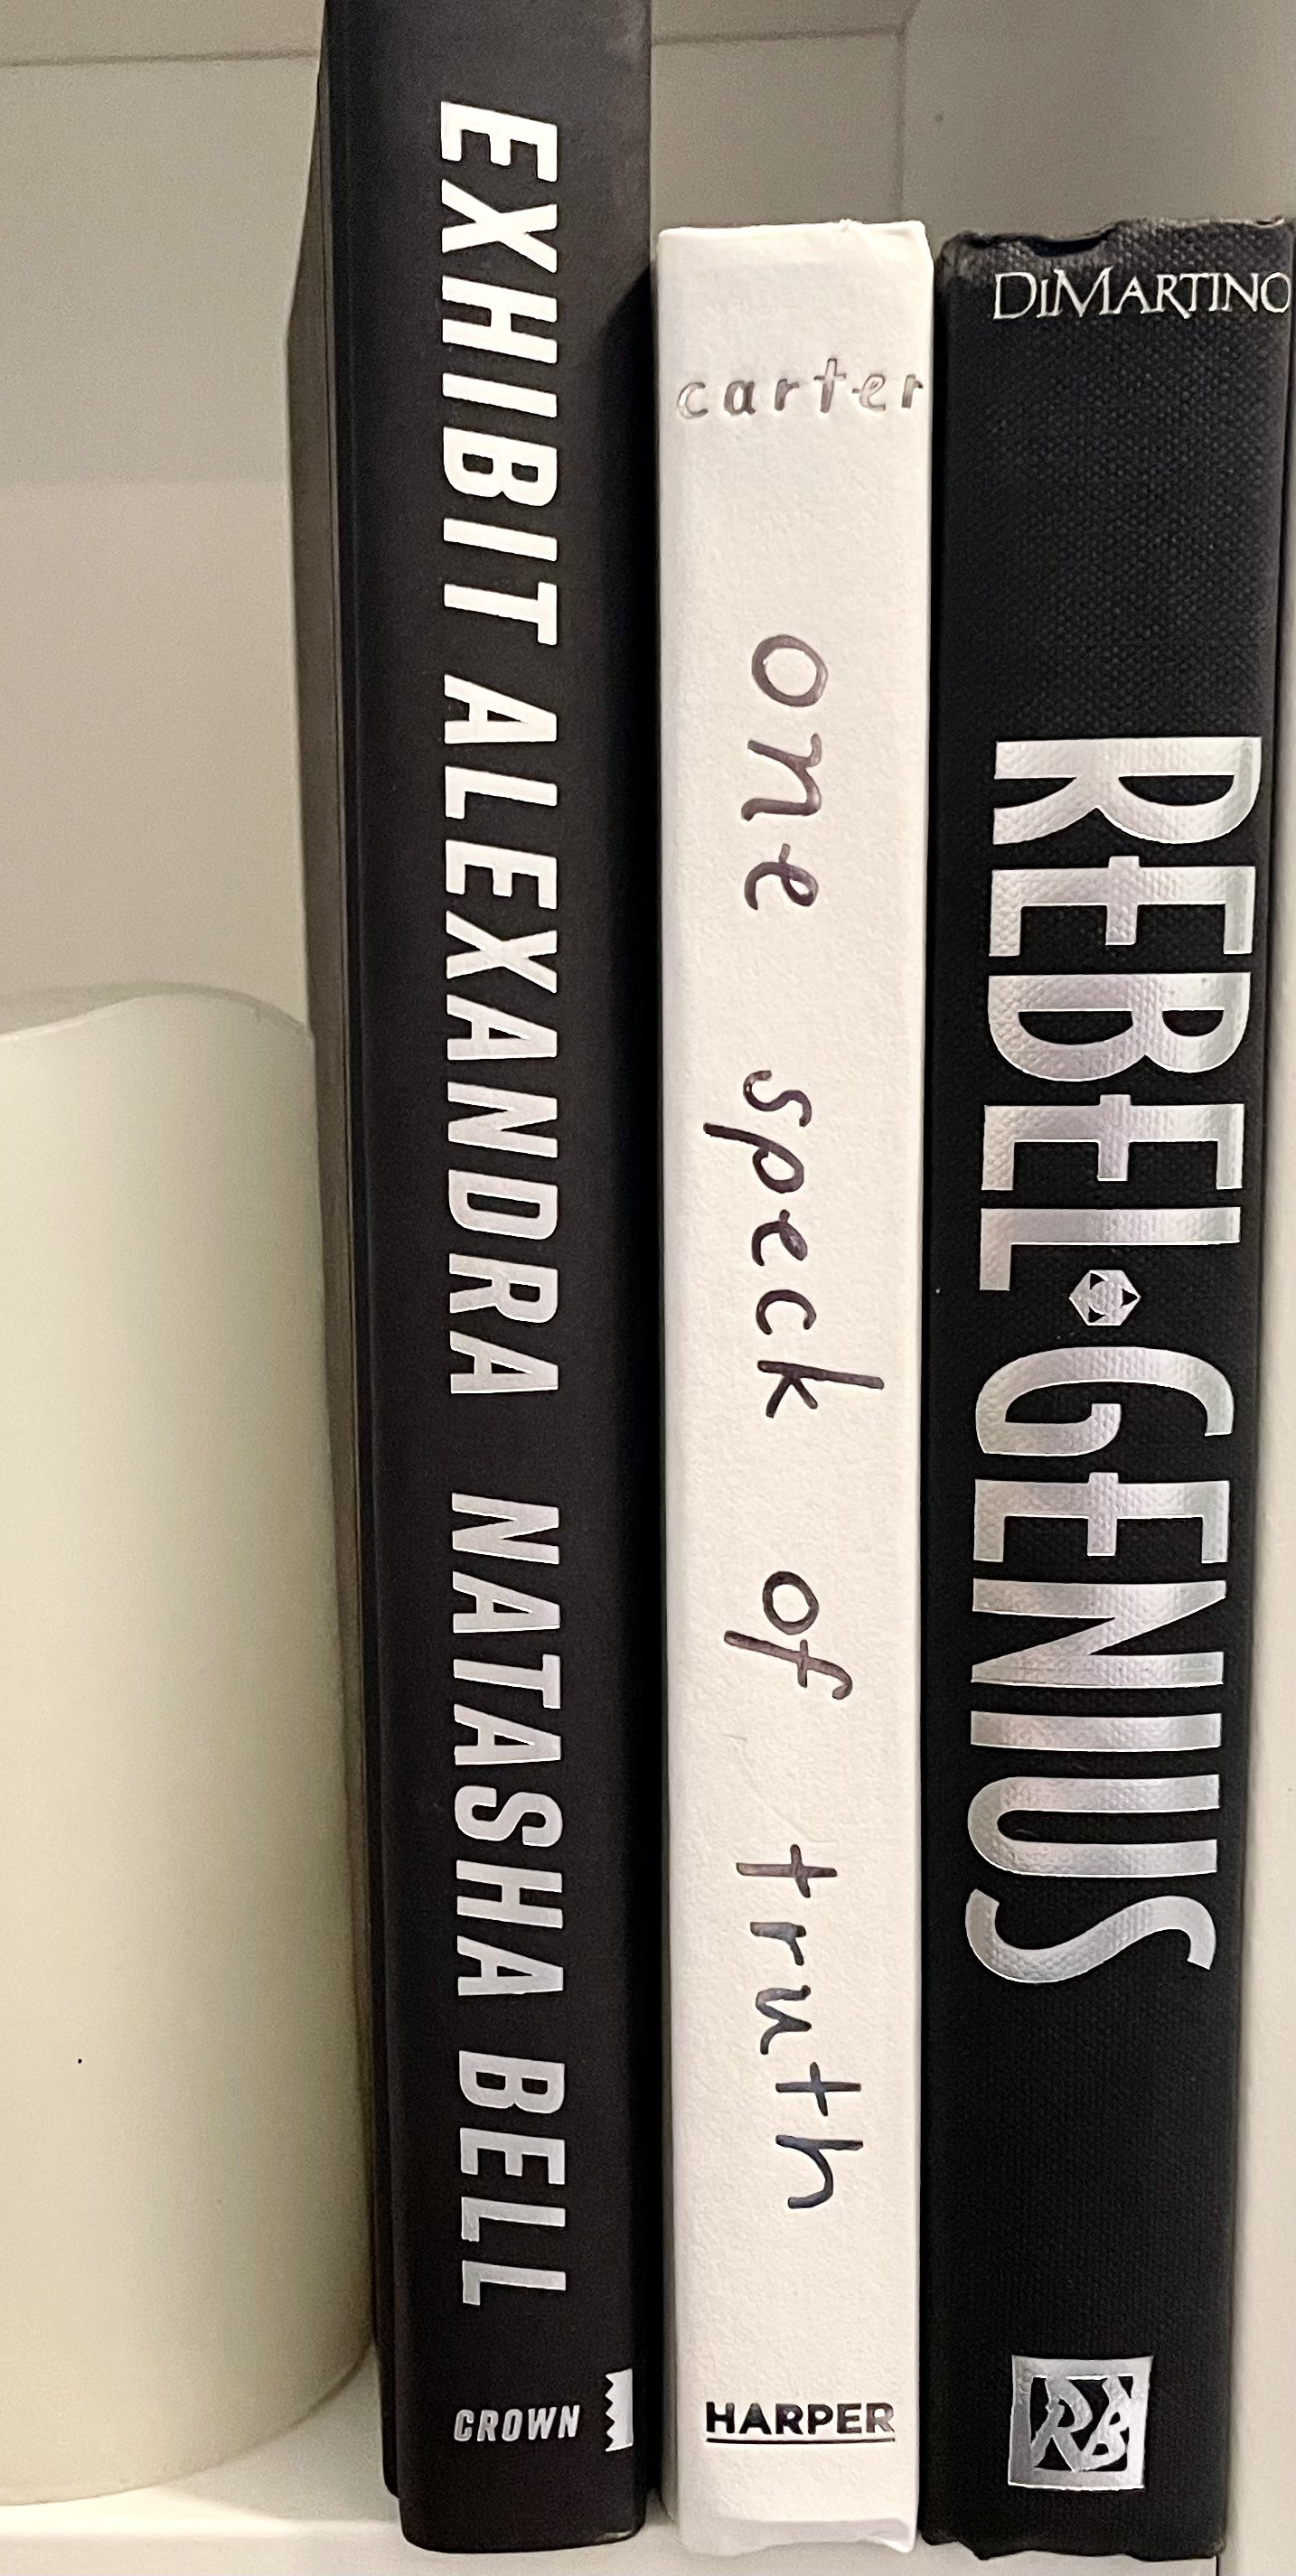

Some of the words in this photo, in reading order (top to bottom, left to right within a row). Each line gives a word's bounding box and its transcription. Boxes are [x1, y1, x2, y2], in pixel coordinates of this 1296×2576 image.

[440, 100, 559, 646] EXHIBIT
[677, 357, 924, 418] carter
[741, 633, 828, 912] one
[444, 673, 559, 1395] ALEXANDRA
[979, 736, 1262, 1291] REBEL
[701, 1069, 886, 1419] speck
[450, 1492, 564, 1997] NATASHA
[723, 1569, 854, 1701] of
[965, 1346, 1235, 1985] GENIUS
[458, 2050, 568, 2307] BELL
[736, 1842, 865, 2212] truth
[453, 2404, 581, 2443] CROWN
[705, 2401, 896, 2436] HARPER
